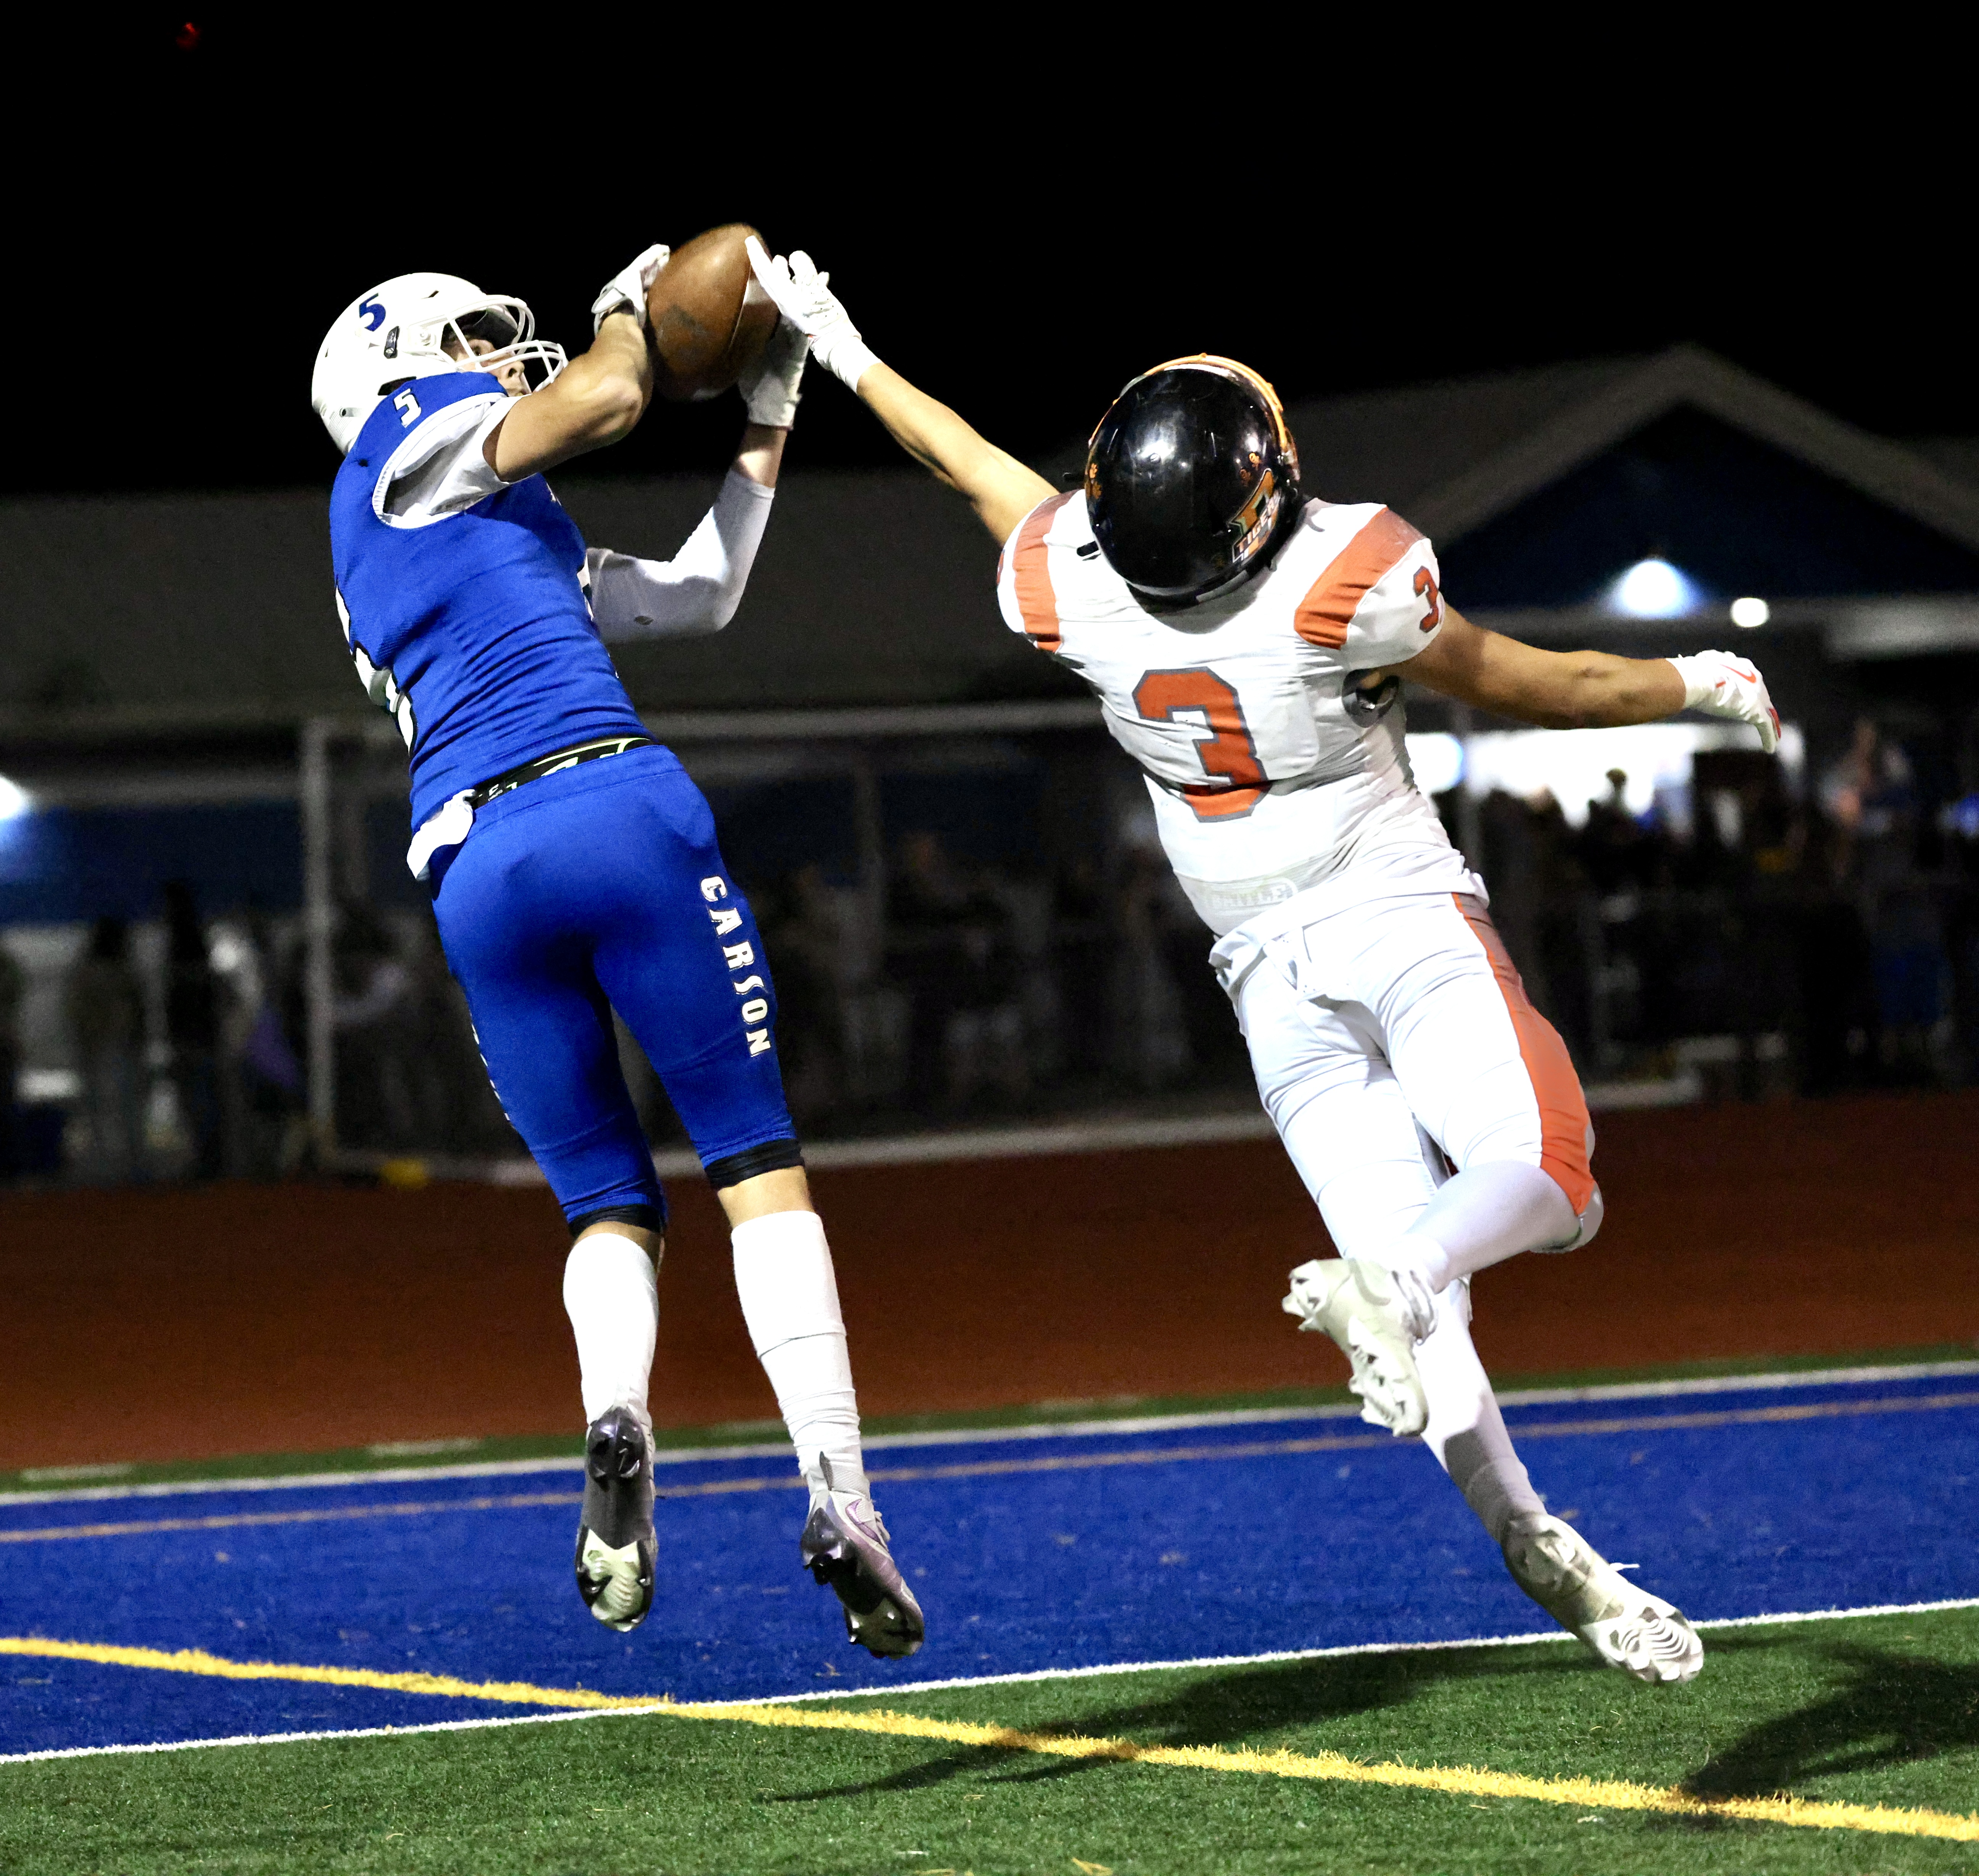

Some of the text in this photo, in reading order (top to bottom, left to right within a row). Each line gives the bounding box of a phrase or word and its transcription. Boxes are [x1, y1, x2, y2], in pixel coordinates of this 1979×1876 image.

[359, 293, 386, 332] 5
[393, 388, 421, 428] 5
[1413, 565, 1440, 634] 3
[1131, 666, 1271, 823] 3
[700, 876, 771, 1058] CARSON
